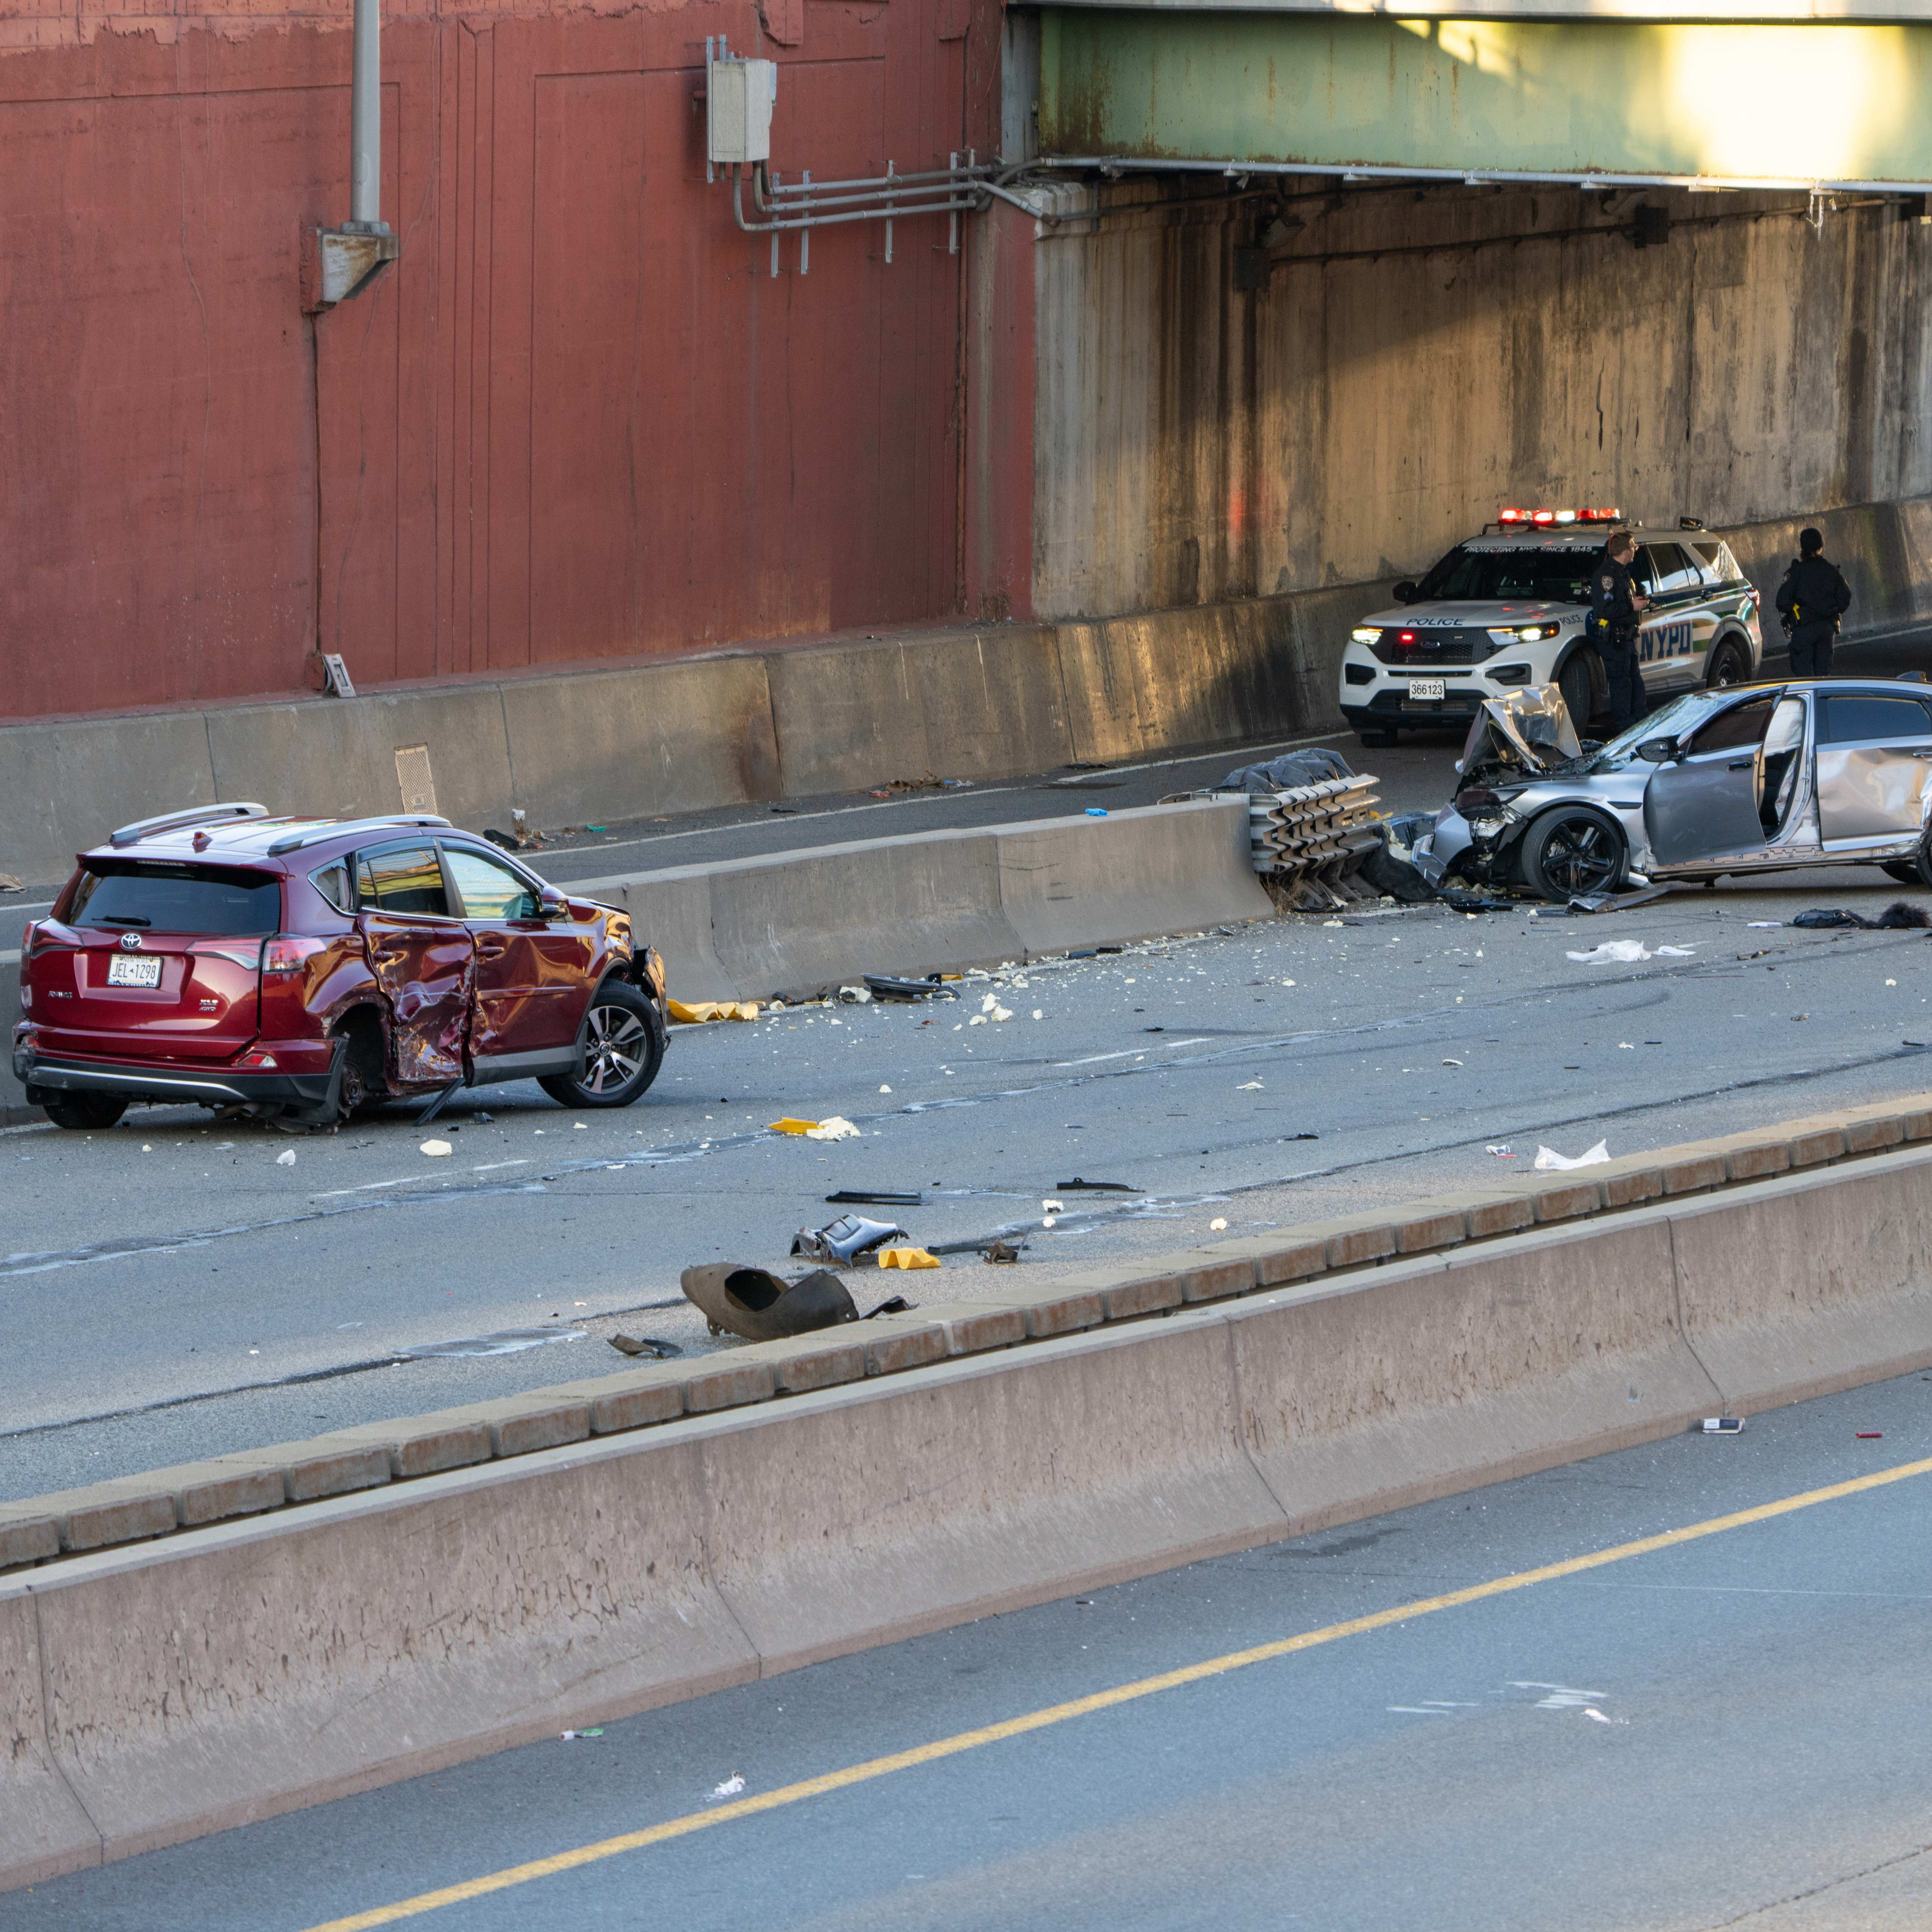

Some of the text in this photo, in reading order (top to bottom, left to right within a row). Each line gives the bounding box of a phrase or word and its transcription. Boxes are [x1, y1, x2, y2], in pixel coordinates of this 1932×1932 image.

[1406, 618, 1465, 626] POLICE
[1559, 614, 1583, 626] POLICE
[1639, 623, 1691, 662] NYPD
[1411, 684, 1443, 695] 366123
